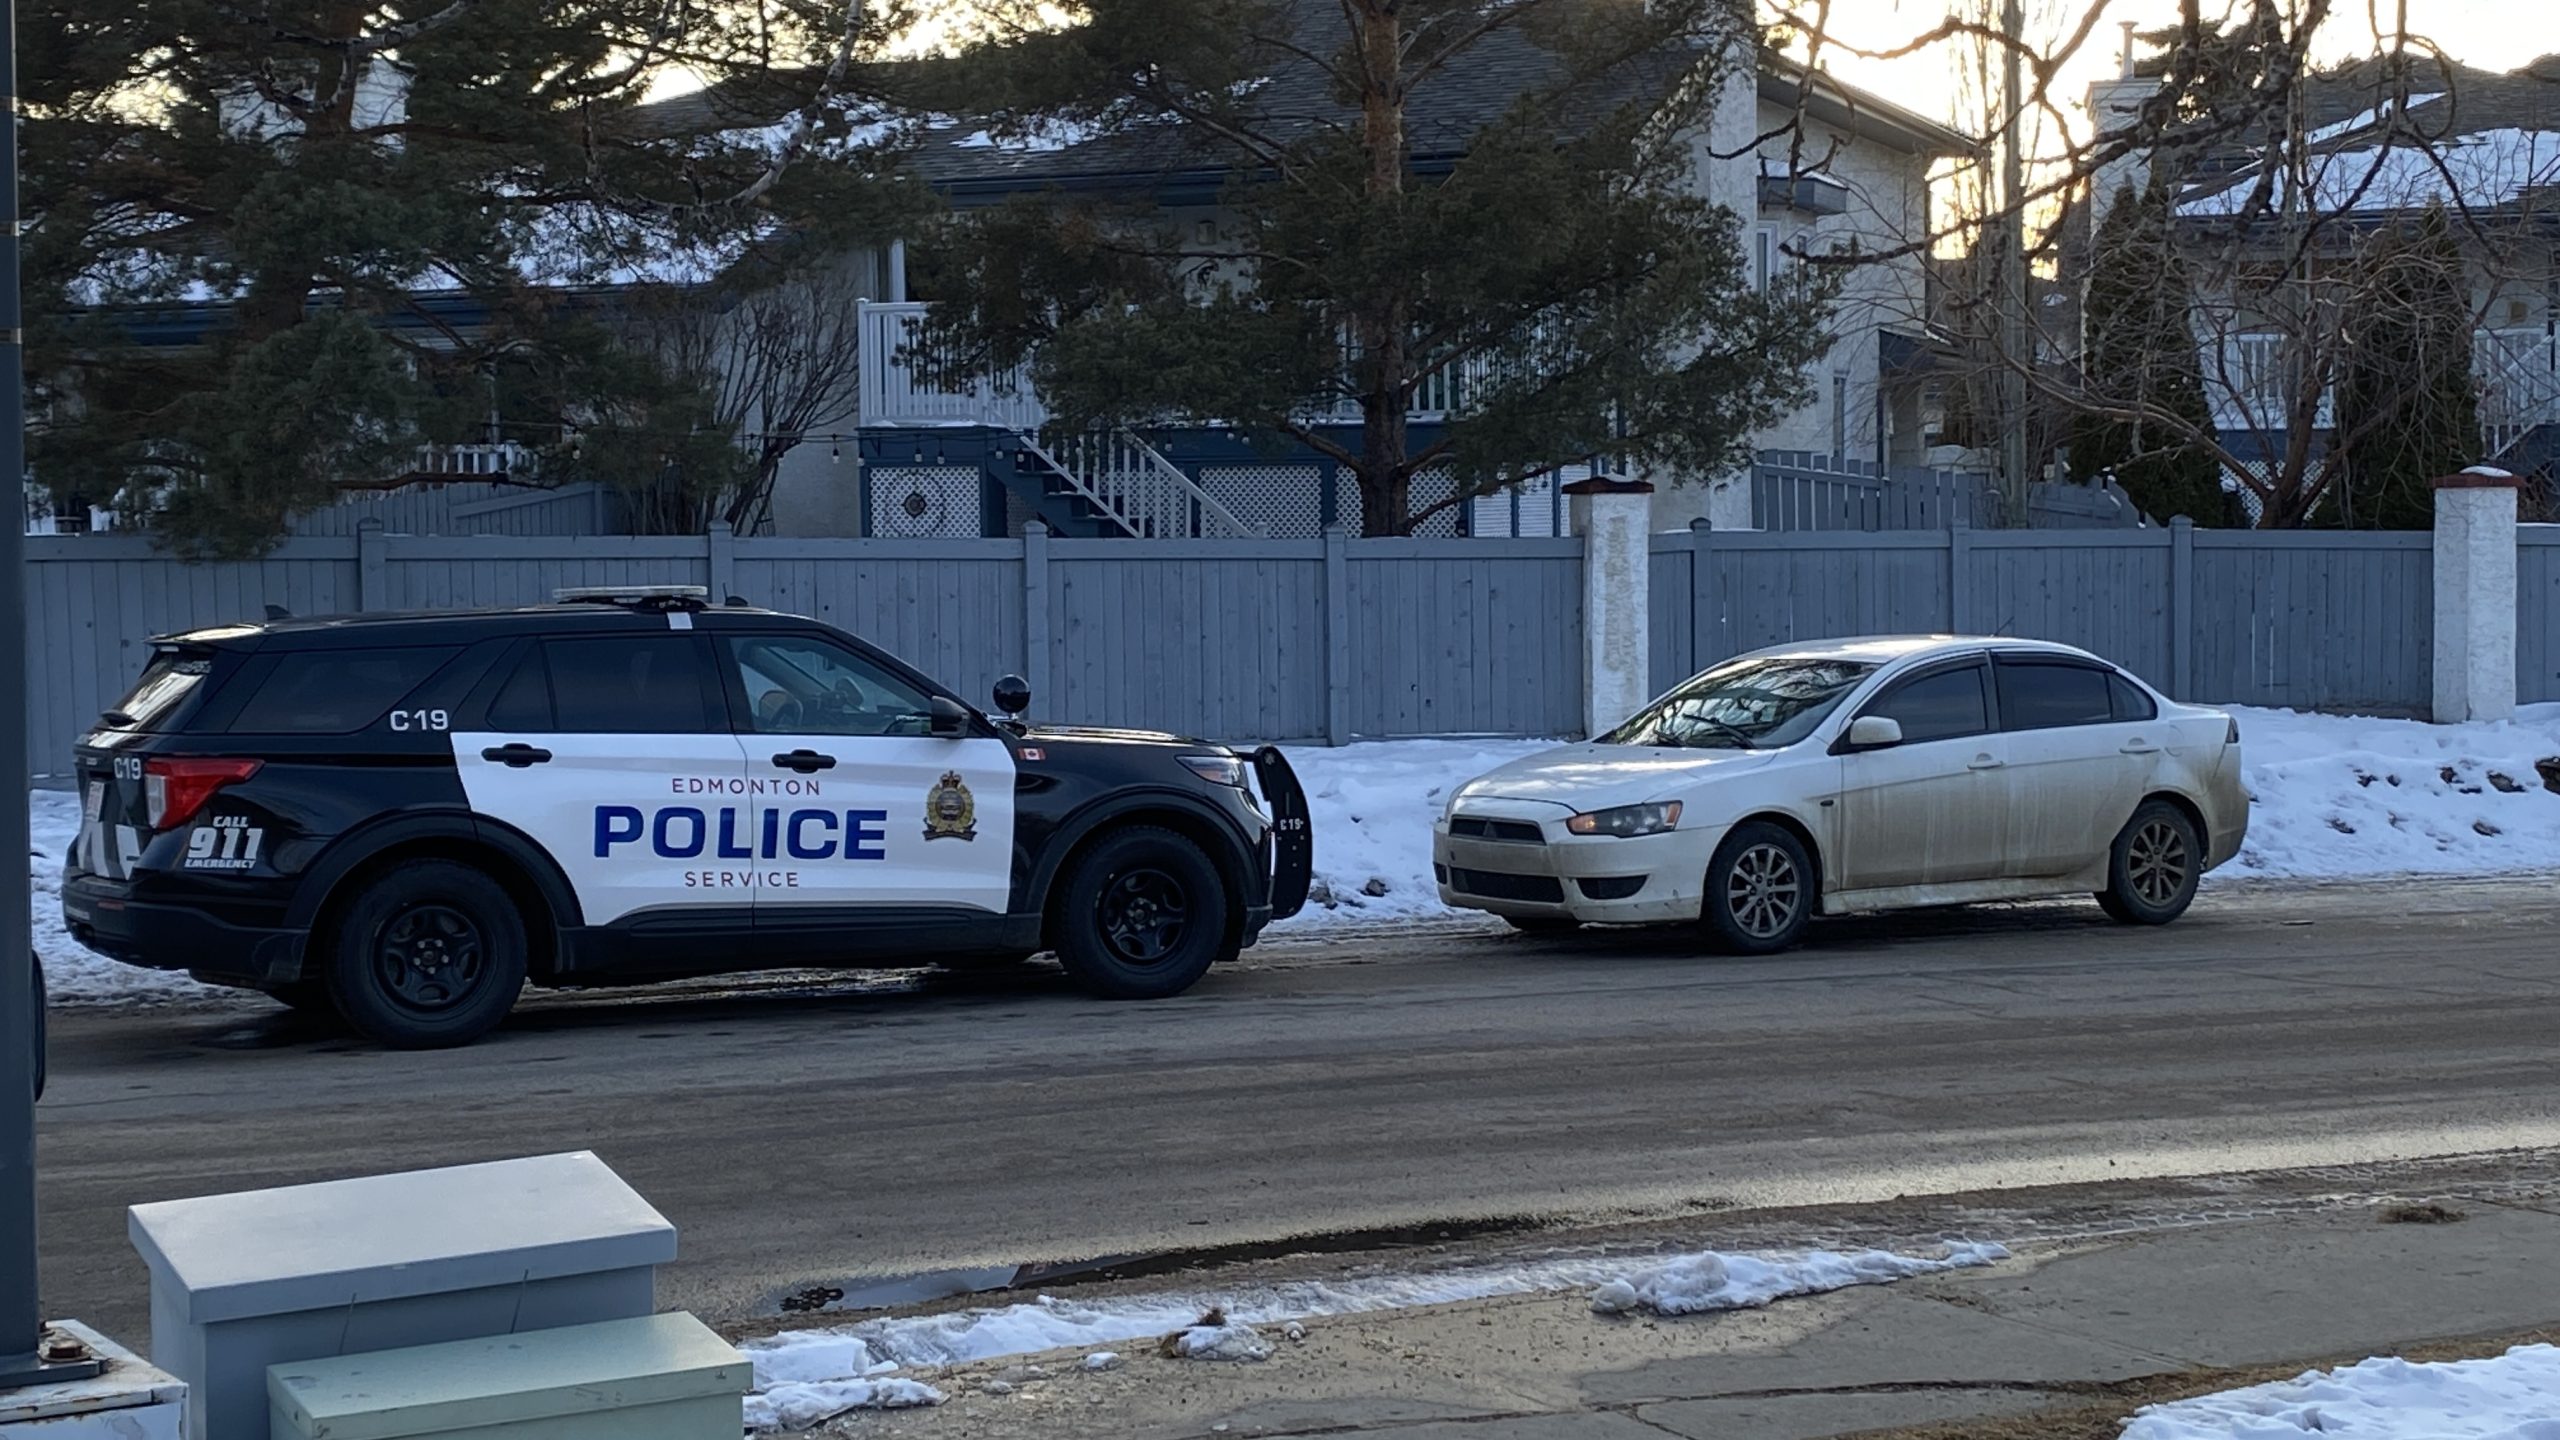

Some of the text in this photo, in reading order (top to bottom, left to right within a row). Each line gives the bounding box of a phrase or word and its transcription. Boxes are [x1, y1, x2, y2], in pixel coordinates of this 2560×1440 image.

[390, 709, 449, 731] C19
[114, 757, 142, 780] C19
[672, 778, 820, 796] EDMONTON
[212, 816, 249, 828] CALL
[594, 805, 888, 860] POLICE
[187, 827, 263, 860] 911
[684, 871, 799, 888] SERVICE
